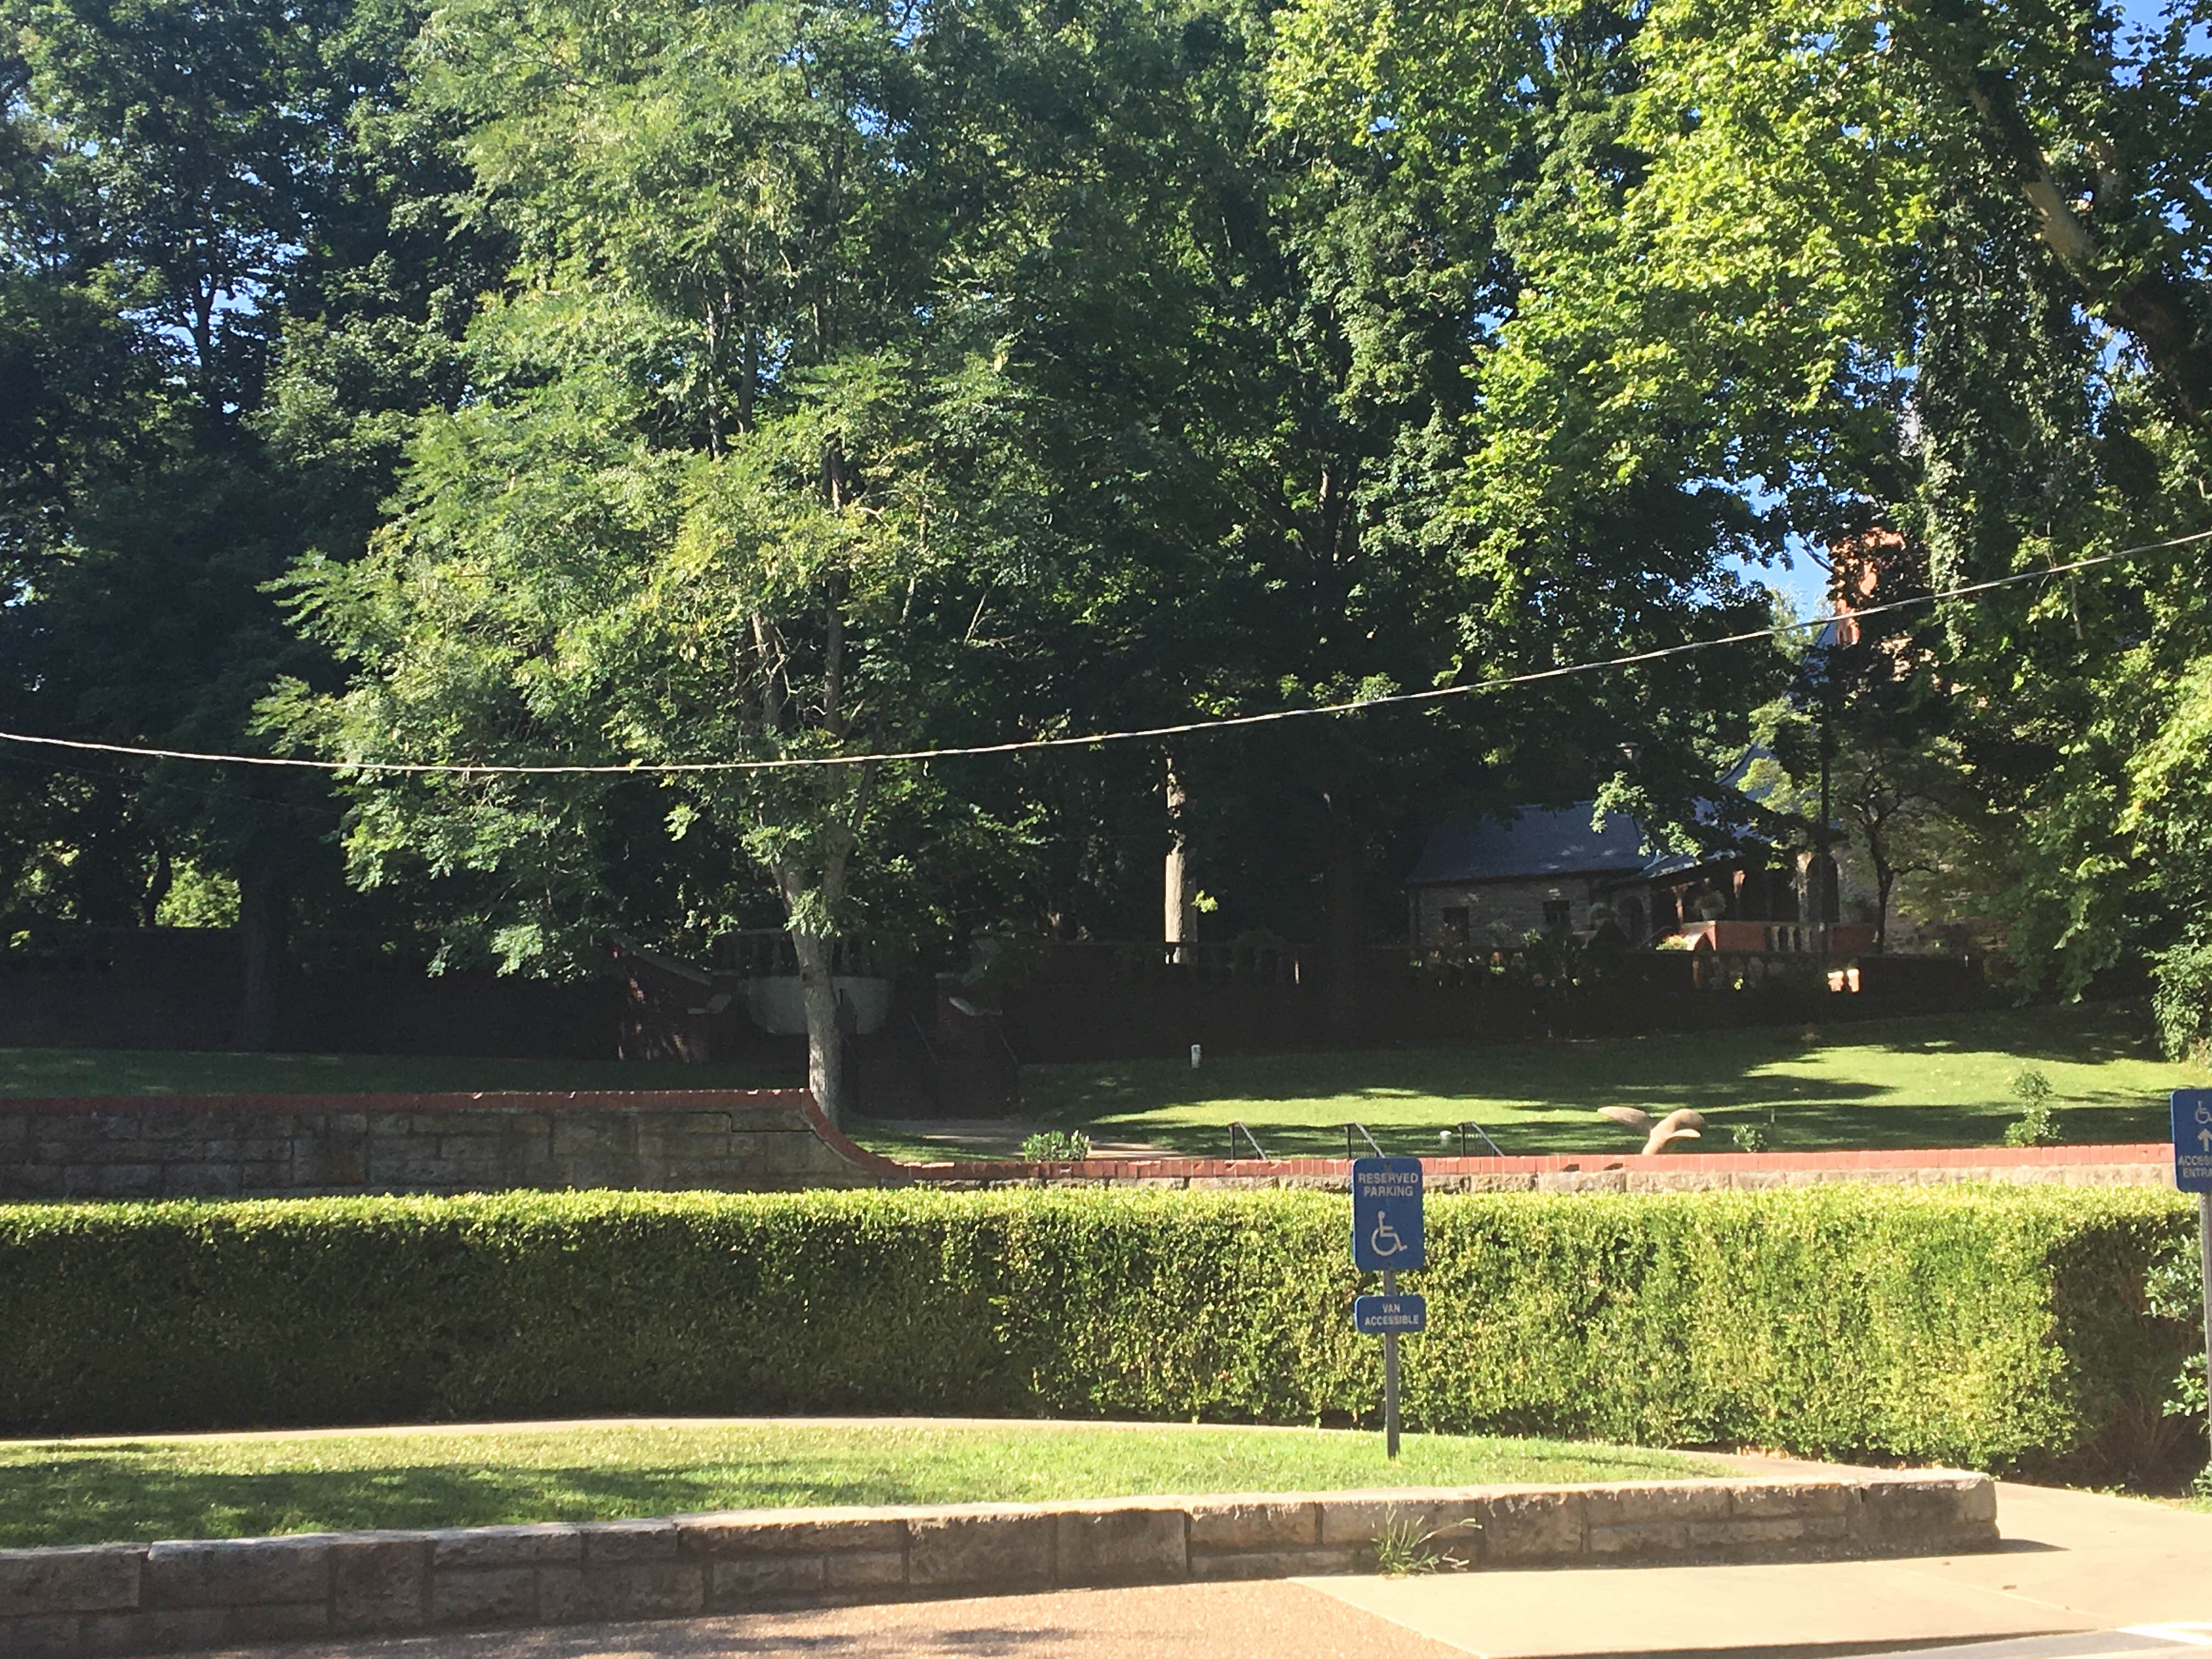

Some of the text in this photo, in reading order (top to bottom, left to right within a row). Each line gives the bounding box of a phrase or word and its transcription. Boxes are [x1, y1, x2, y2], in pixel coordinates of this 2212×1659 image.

[1358, 1172, 1419, 1184] RESERVED
[1364, 1186, 1413, 1197] PARKING
[1383, 1304, 1400, 1313] VAN
[1364, 1315, 1419, 1325] ACCESSIBLE
